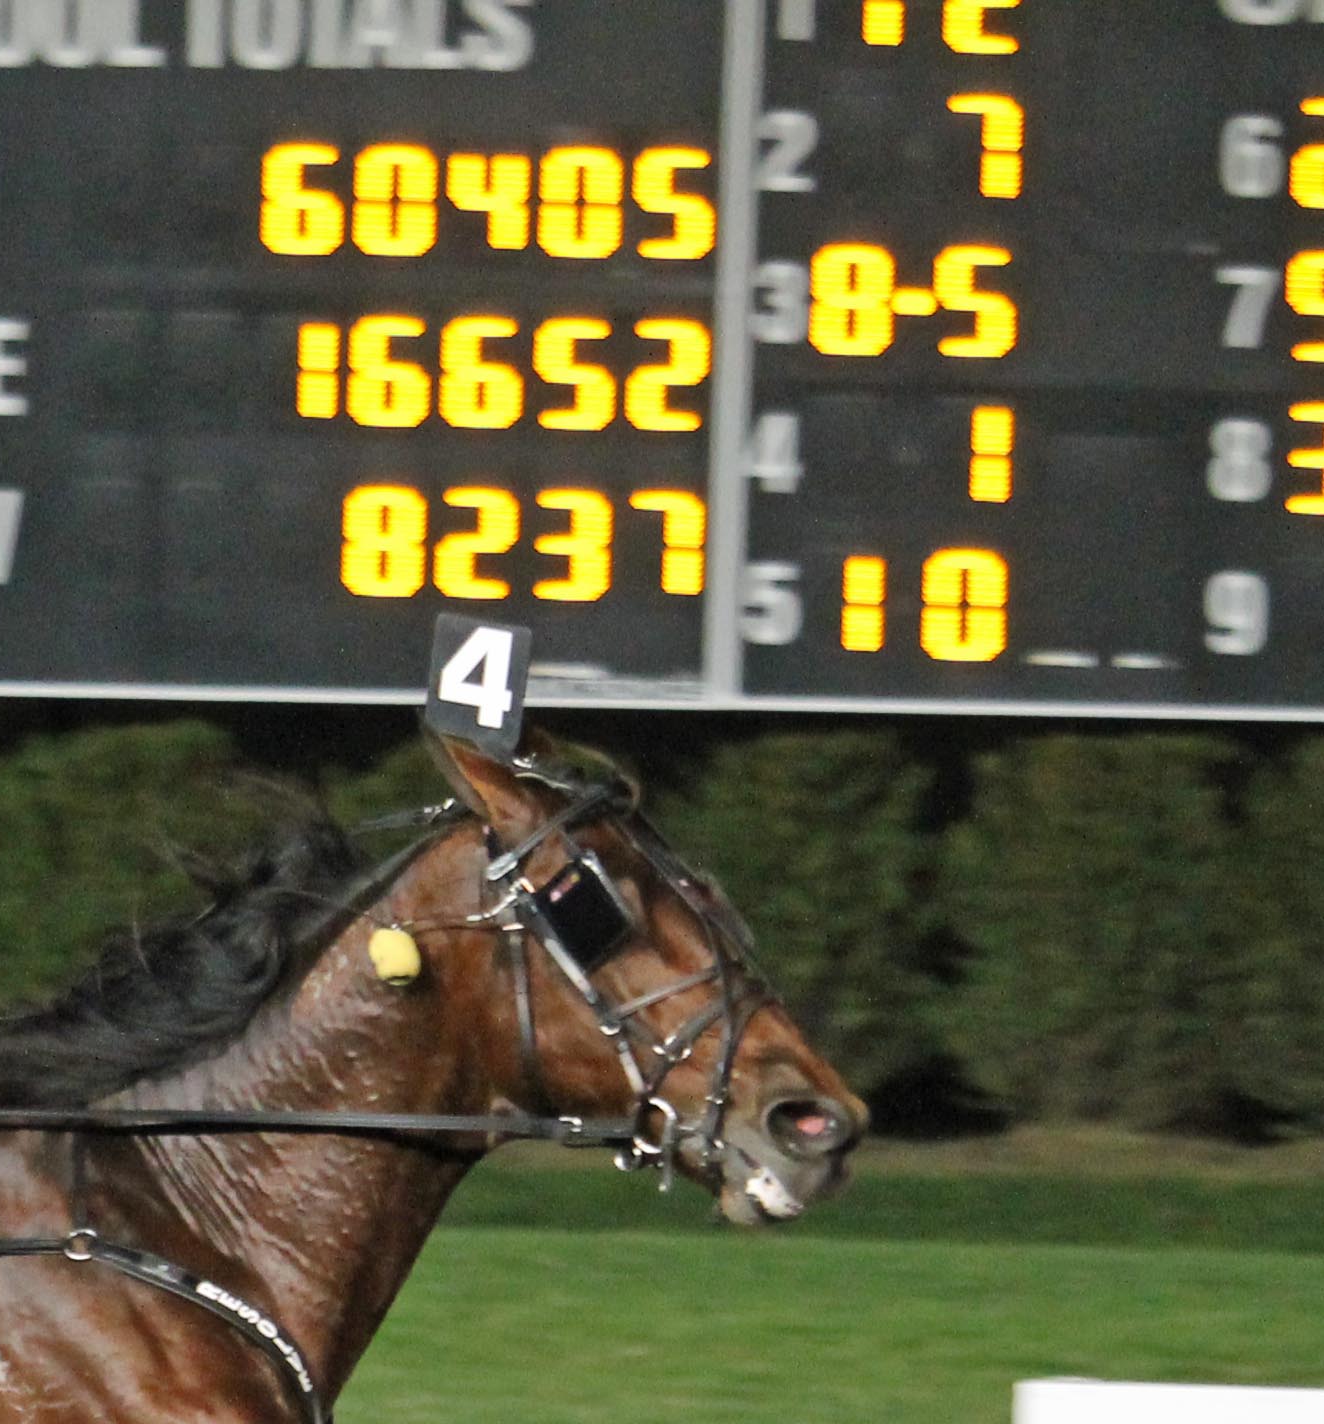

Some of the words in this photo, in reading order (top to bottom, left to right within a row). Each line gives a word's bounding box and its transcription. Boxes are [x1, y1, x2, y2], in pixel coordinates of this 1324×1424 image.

[185, 0, 534, 70] TOTALS
[755, 109, 818, 192] 2
[946, 92, 1025, 199] 7
[1218, 113, 1284, 198] 6
[258, 141, 717, 260] 60405
[754, 260, 809, 343] 3
[808, 241, 1019, 358] 8-5
[1216, 264, 1280, 348] 7
[295, 314, 711, 431] 16652
[742, 411, 804, 494] 4
[968, 404, 1015, 503] 1
[1206, 418, 1273, 501] 8
[340, 483, 707, 601] 8237
[741, 560, 804, 645] 5
[841, 548, 1009, 661] 10
[1203, 570, 1271, 656] 9
[438, 625, 513, 729] 4
